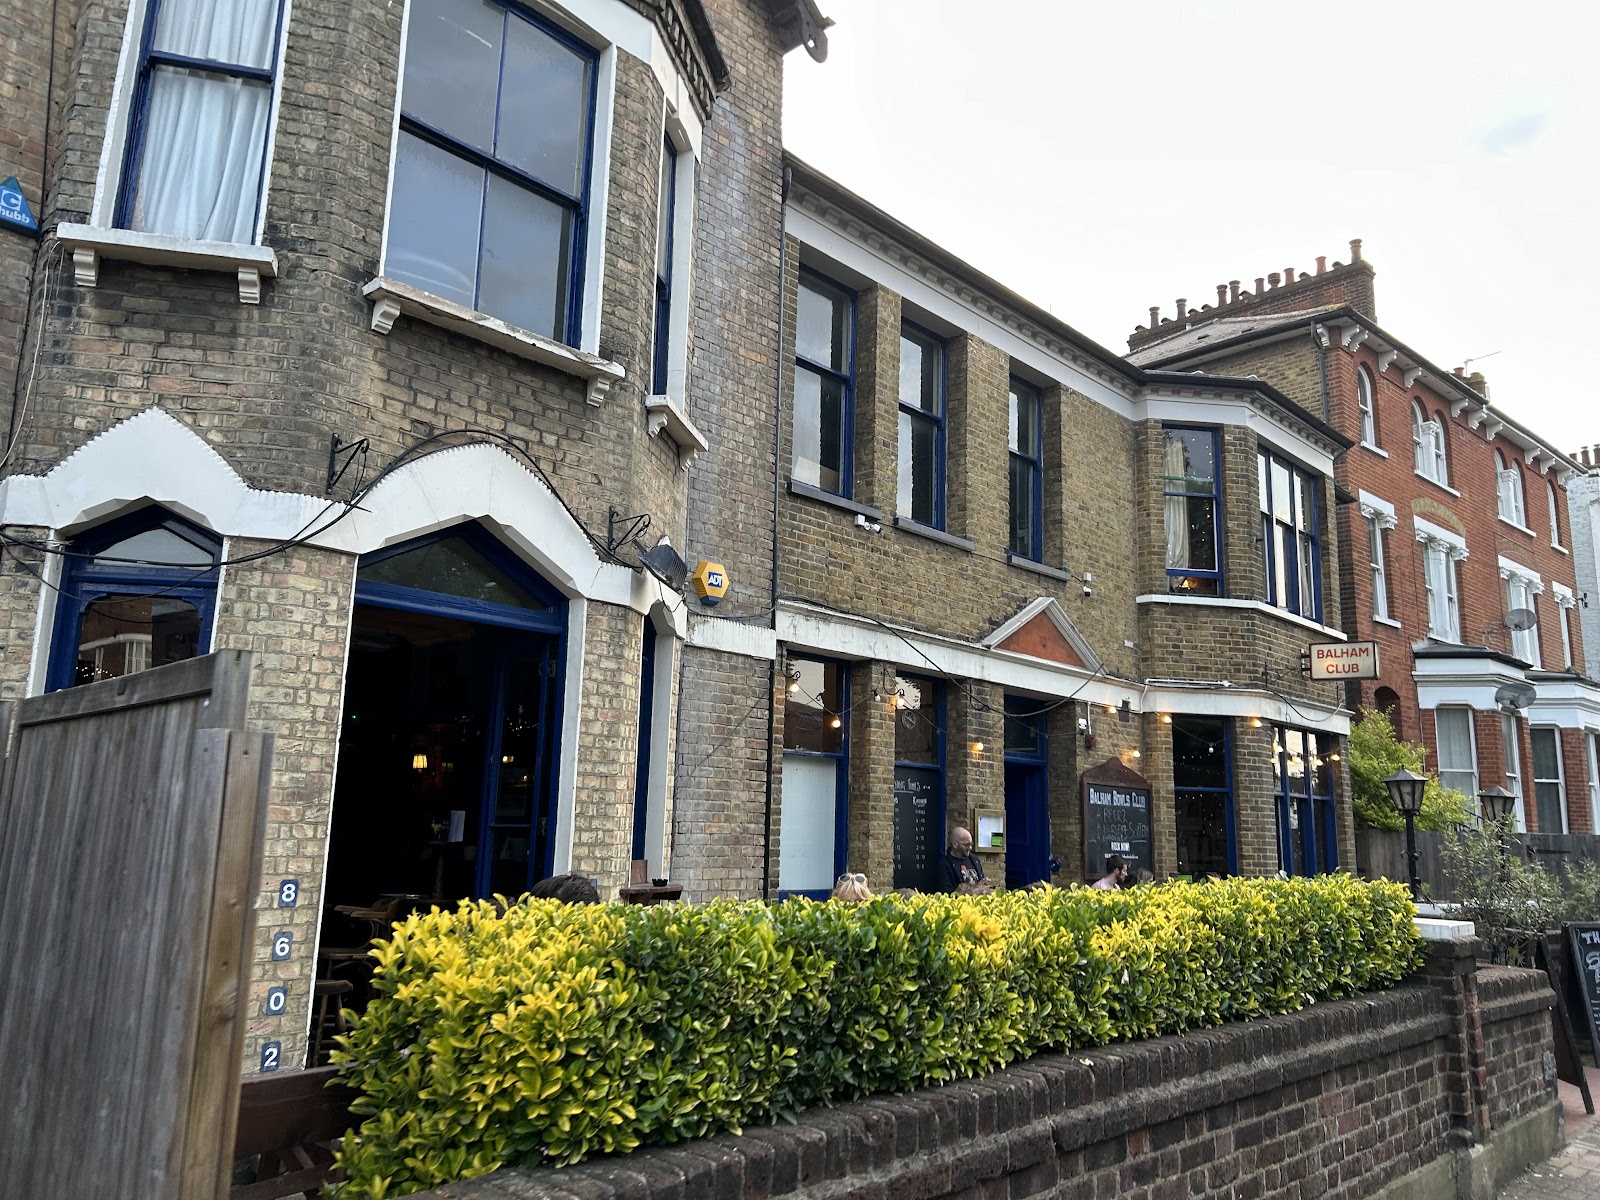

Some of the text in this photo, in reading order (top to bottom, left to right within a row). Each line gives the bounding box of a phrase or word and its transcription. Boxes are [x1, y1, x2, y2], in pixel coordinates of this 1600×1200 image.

[708, 574, 722, 586] ADT
[1317, 647, 1369, 659] BALHAM
[1326, 663, 1360, 674] CLUB
[1112, 790, 1131, 807] BOWLS
[1131, 792, 1146, 808] CLUB
[281, 883, 296, 902] 8
[275, 937, 290, 957] 6
[269, 991, 285, 1011] 0
[263, 1047, 278, 1067] 2
